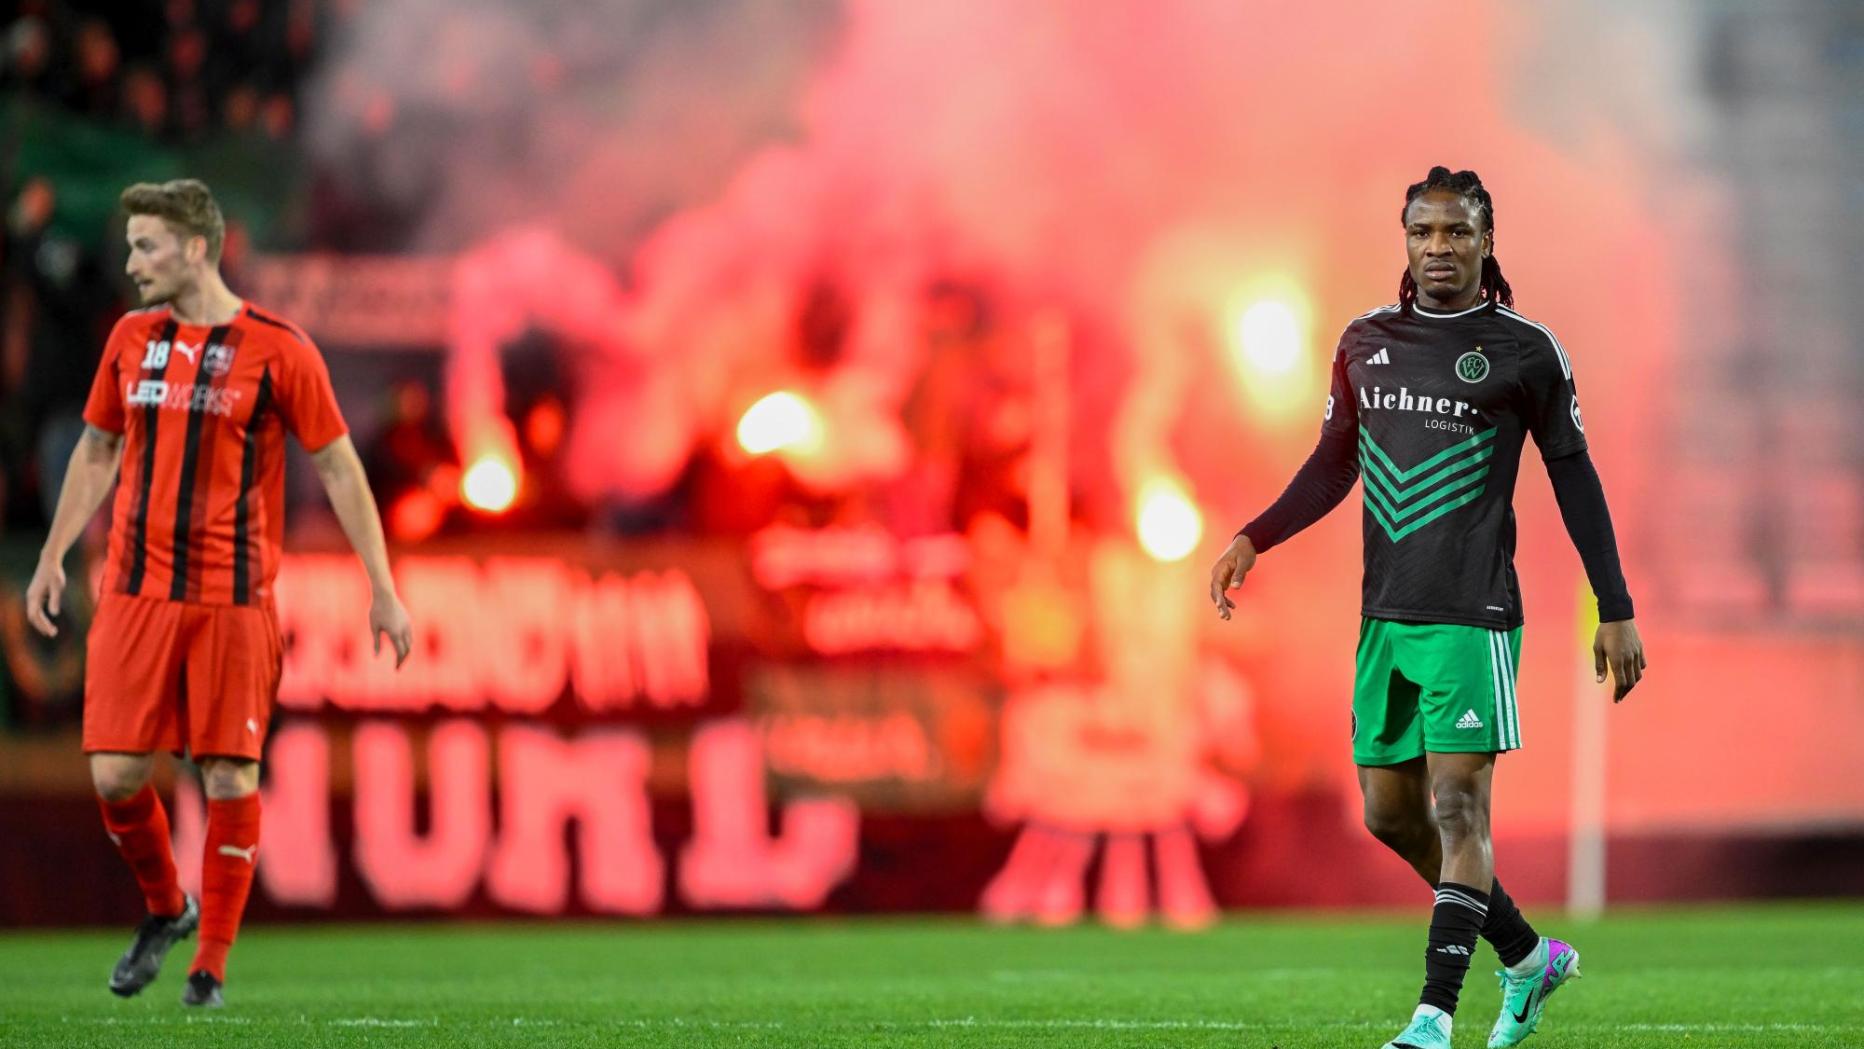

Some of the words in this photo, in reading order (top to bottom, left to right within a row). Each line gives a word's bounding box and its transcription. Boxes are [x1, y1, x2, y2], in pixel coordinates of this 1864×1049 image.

[140, 339, 171, 370] 18
[1424, 419, 1475, 435] LOGISTIK
[1456, 720, 1484, 729] adidas
